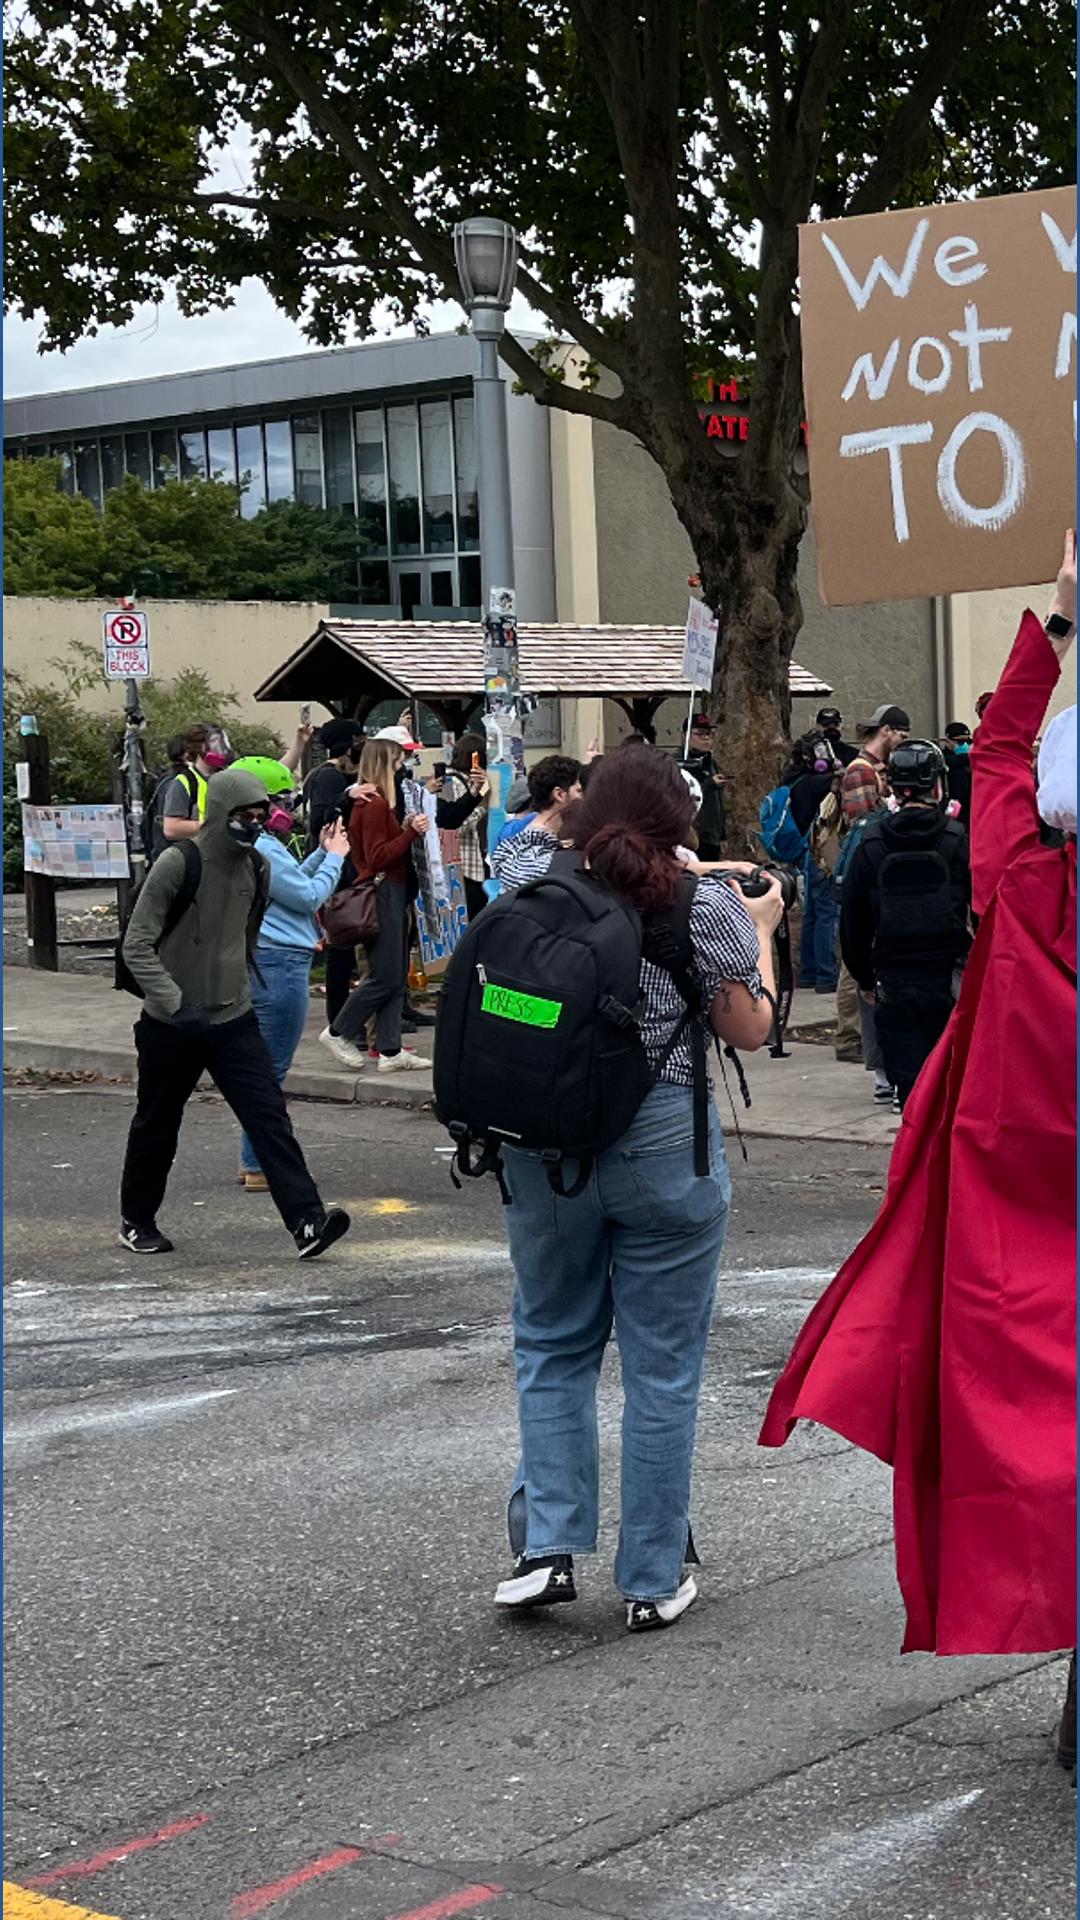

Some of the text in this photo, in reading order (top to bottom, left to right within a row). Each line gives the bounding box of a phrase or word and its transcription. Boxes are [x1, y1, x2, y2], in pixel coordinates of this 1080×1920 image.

[821, 217, 989, 311] We
[839, 410, 1028, 543] TO
[109, 661, 146, 672] BLOCK
[115, 650, 139, 660] THIS
[488, 989, 534, 1018] PRESS
